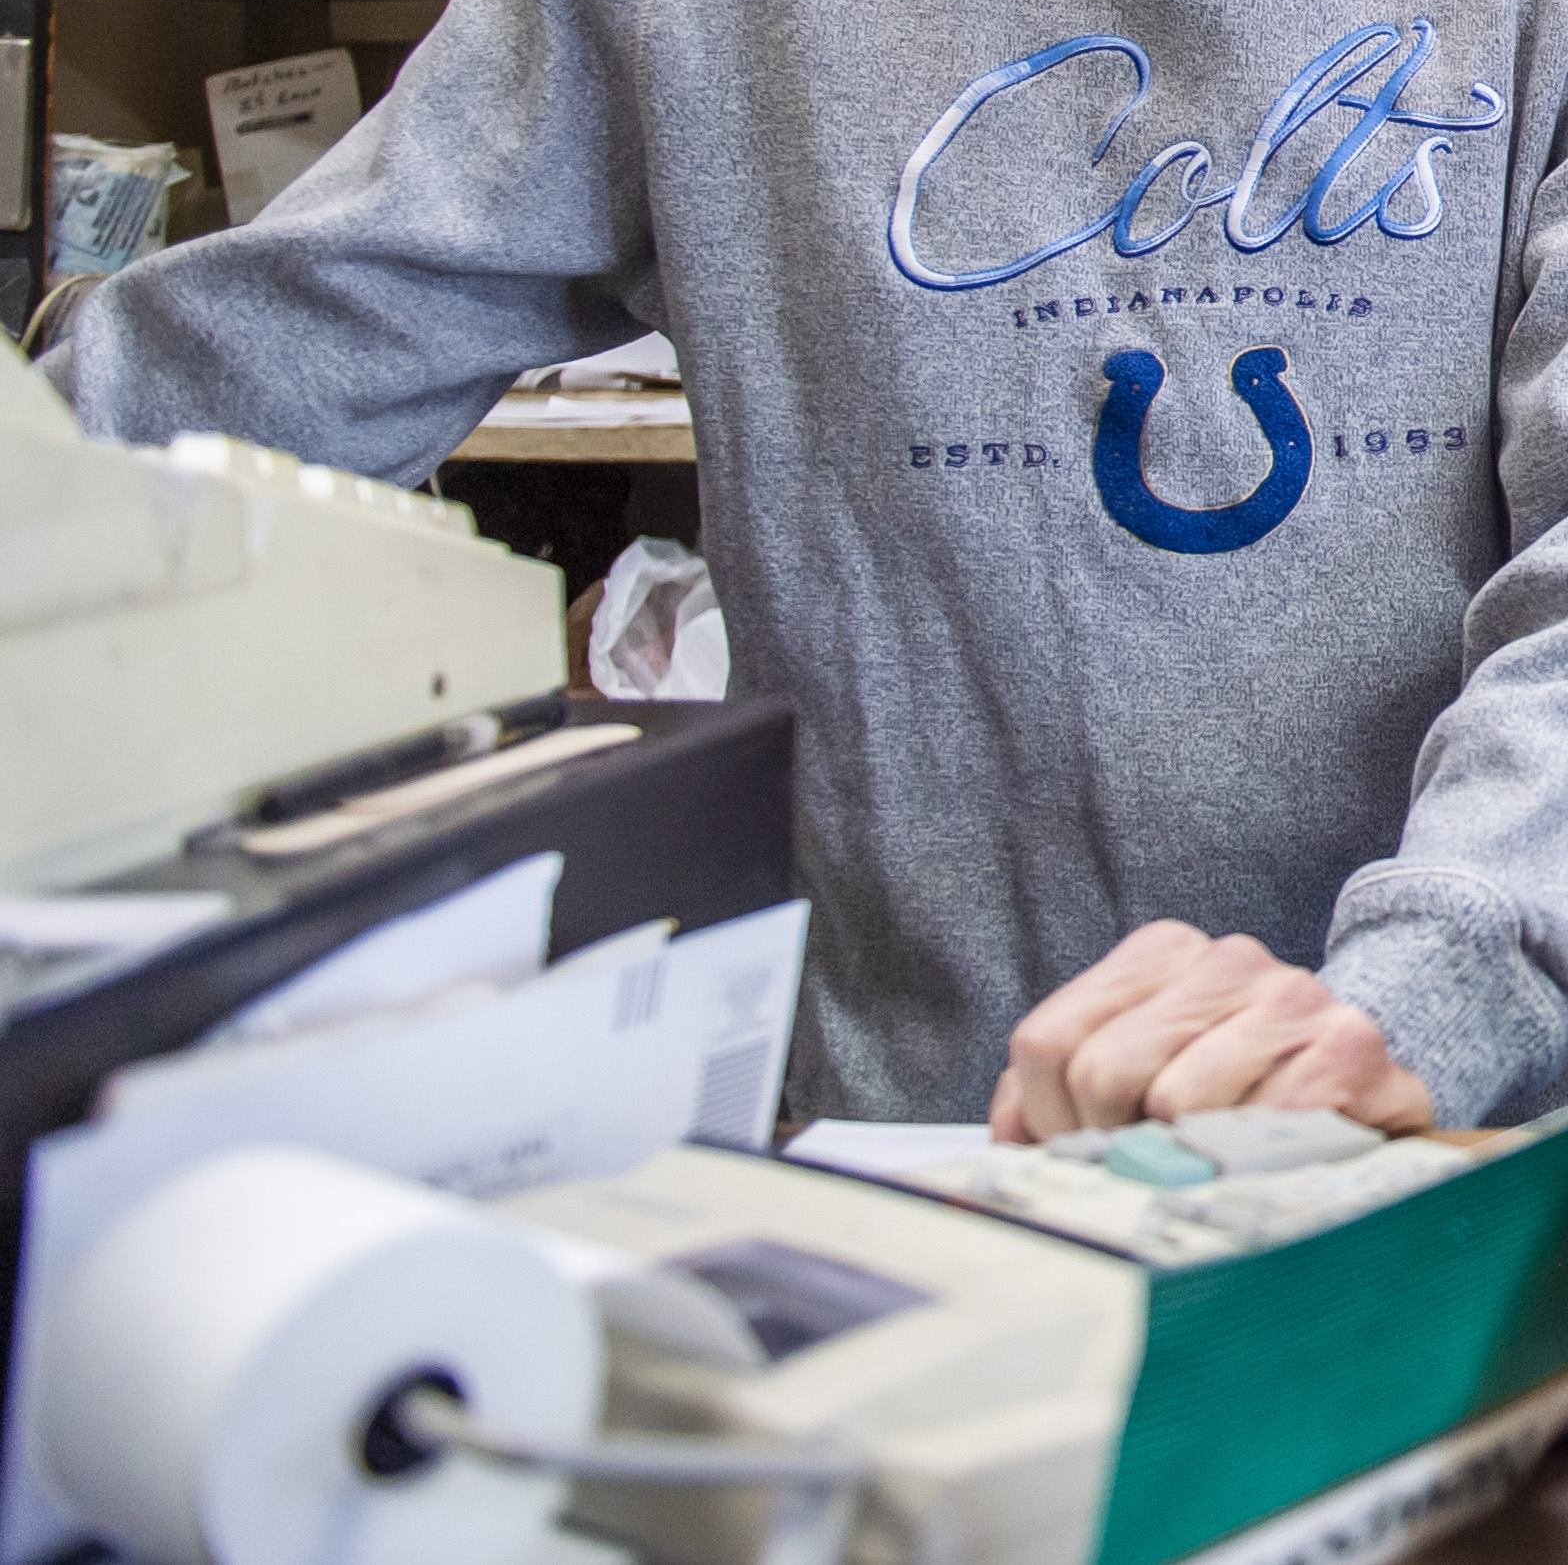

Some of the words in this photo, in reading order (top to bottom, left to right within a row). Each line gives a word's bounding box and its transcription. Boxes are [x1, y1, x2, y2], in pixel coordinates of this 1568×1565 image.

[889, 22, 1504, 291] Colts
[1012, 286, 1375, 329] INDIANAPOLIS
[908, 442, 1062, 470] ESTD.
[1333, 425, 1468, 459] 1953
